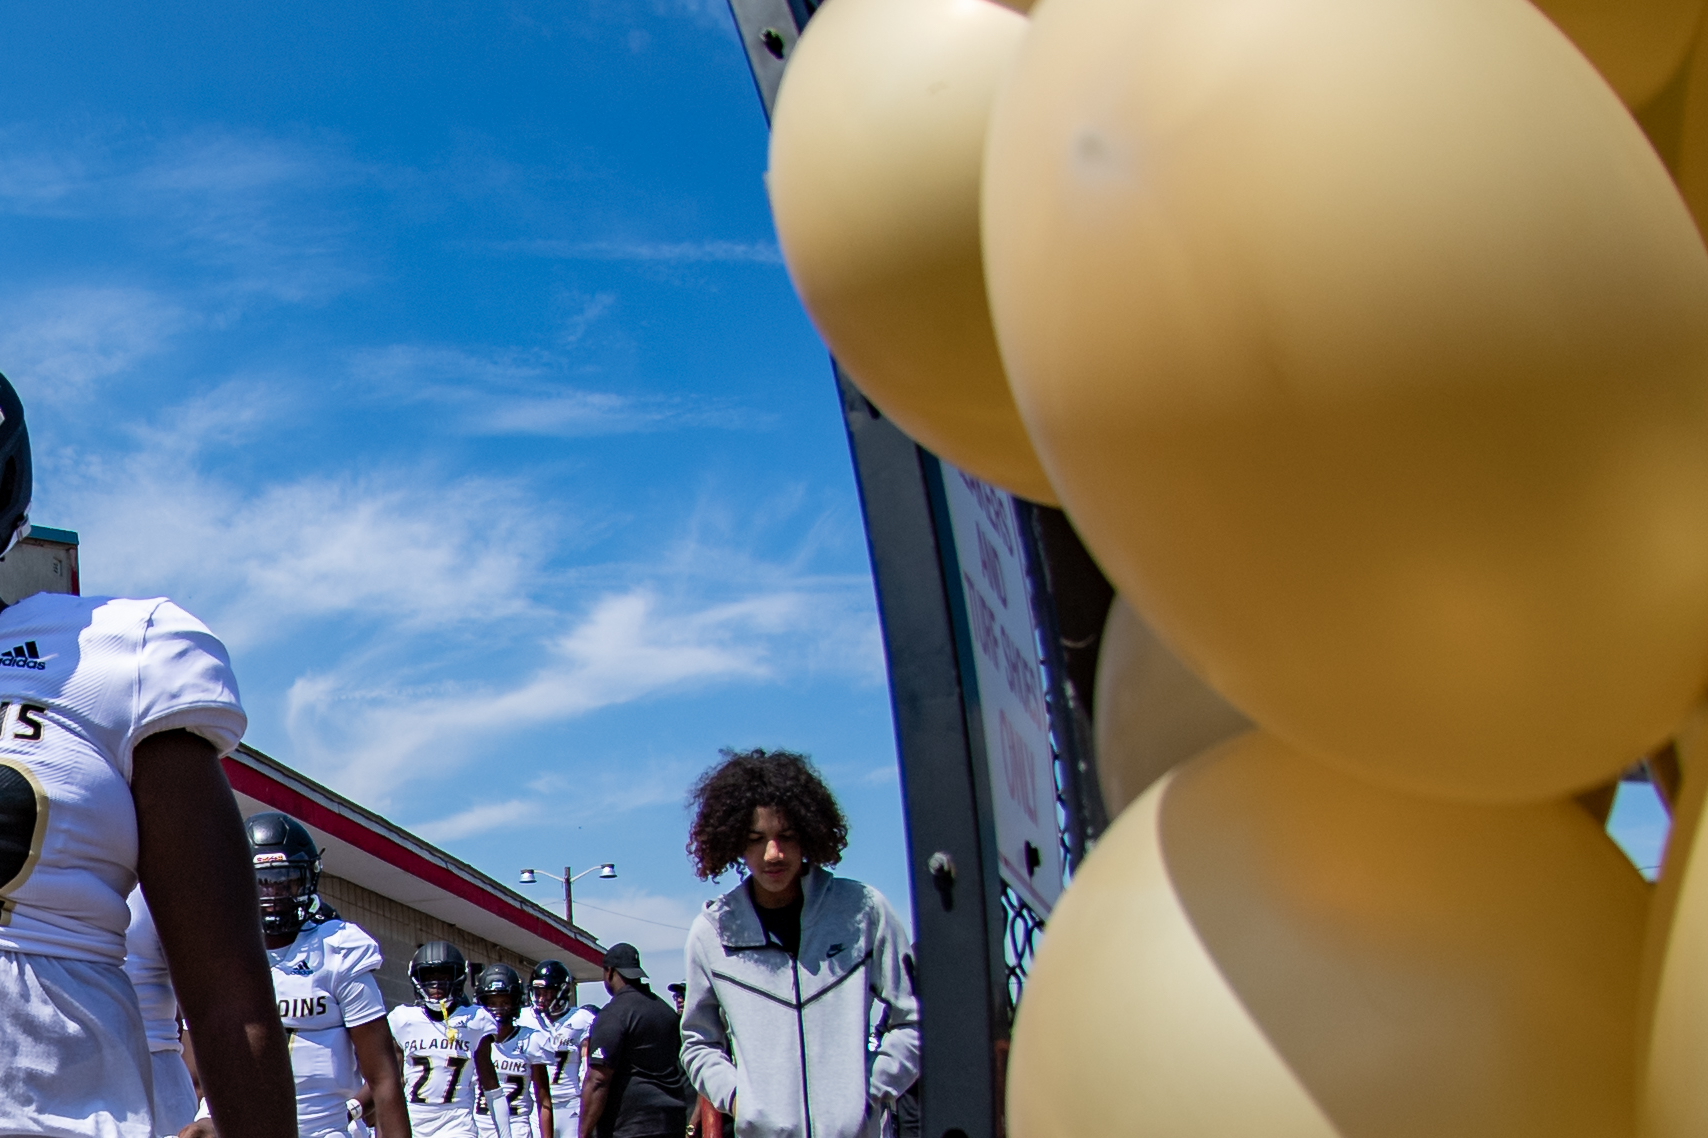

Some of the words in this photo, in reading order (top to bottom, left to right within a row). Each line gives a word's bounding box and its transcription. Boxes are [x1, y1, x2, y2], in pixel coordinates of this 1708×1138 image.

[975, 520, 1007, 610] AND
[963, 569, 999, 673] TURF
[999, 708, 1038, 829] ONLY
[410, 1056, 470, 1103] 27
